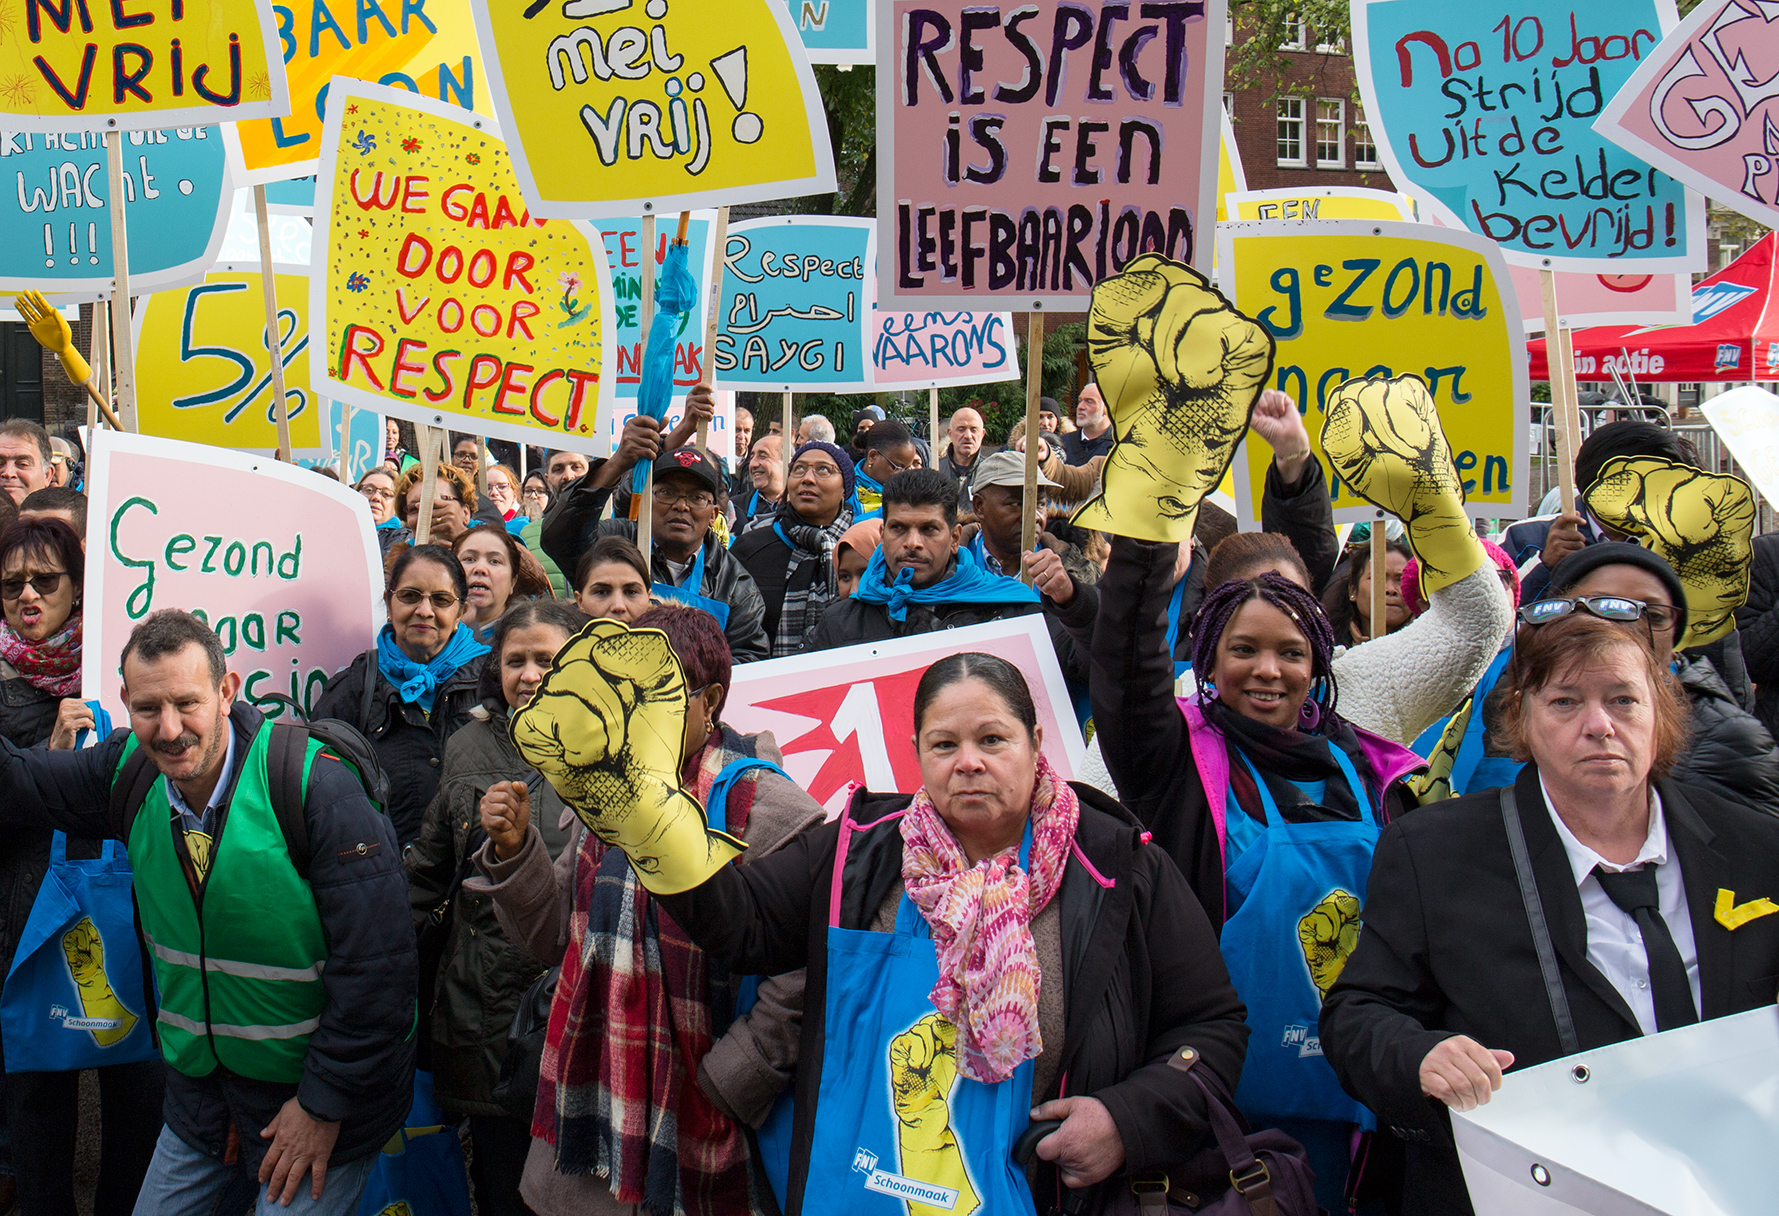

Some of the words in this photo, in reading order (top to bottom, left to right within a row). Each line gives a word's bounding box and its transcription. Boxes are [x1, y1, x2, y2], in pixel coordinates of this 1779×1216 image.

[901, 1, 1205, 108] RESPECT
[1492, 14, 1544, 63] 10
[1441, 66, 1603, 122] Strijd
[350, 168, 430, 213] WE
[396, 232, 536, 294] DOOR
[723, 234, 864, 284] Respect
[395, 287, 541, 341] VOOR
[1256, 258, 1489, 342] gezond
[172, 282, 309, 424] 5%
[714, 334, 845, 374] SAYGI
[1601, 348, 1665, 375] actie
[1716, 348, 1741, 363] FNV
[109, 495, 303, 620] Gezond
[1533, 602, 1564, 615] FNV
[830, 682, 898, 793] 1
[50, 1007, 69, 1018] FNV
[68, 1018, 118, 1028] Schoonmaak
[1283, 1029, 1306, 1043] FNV
[854, 1153, 877, 1171] FNV
[873, 1174, 949, 1203] Schoonmaak
